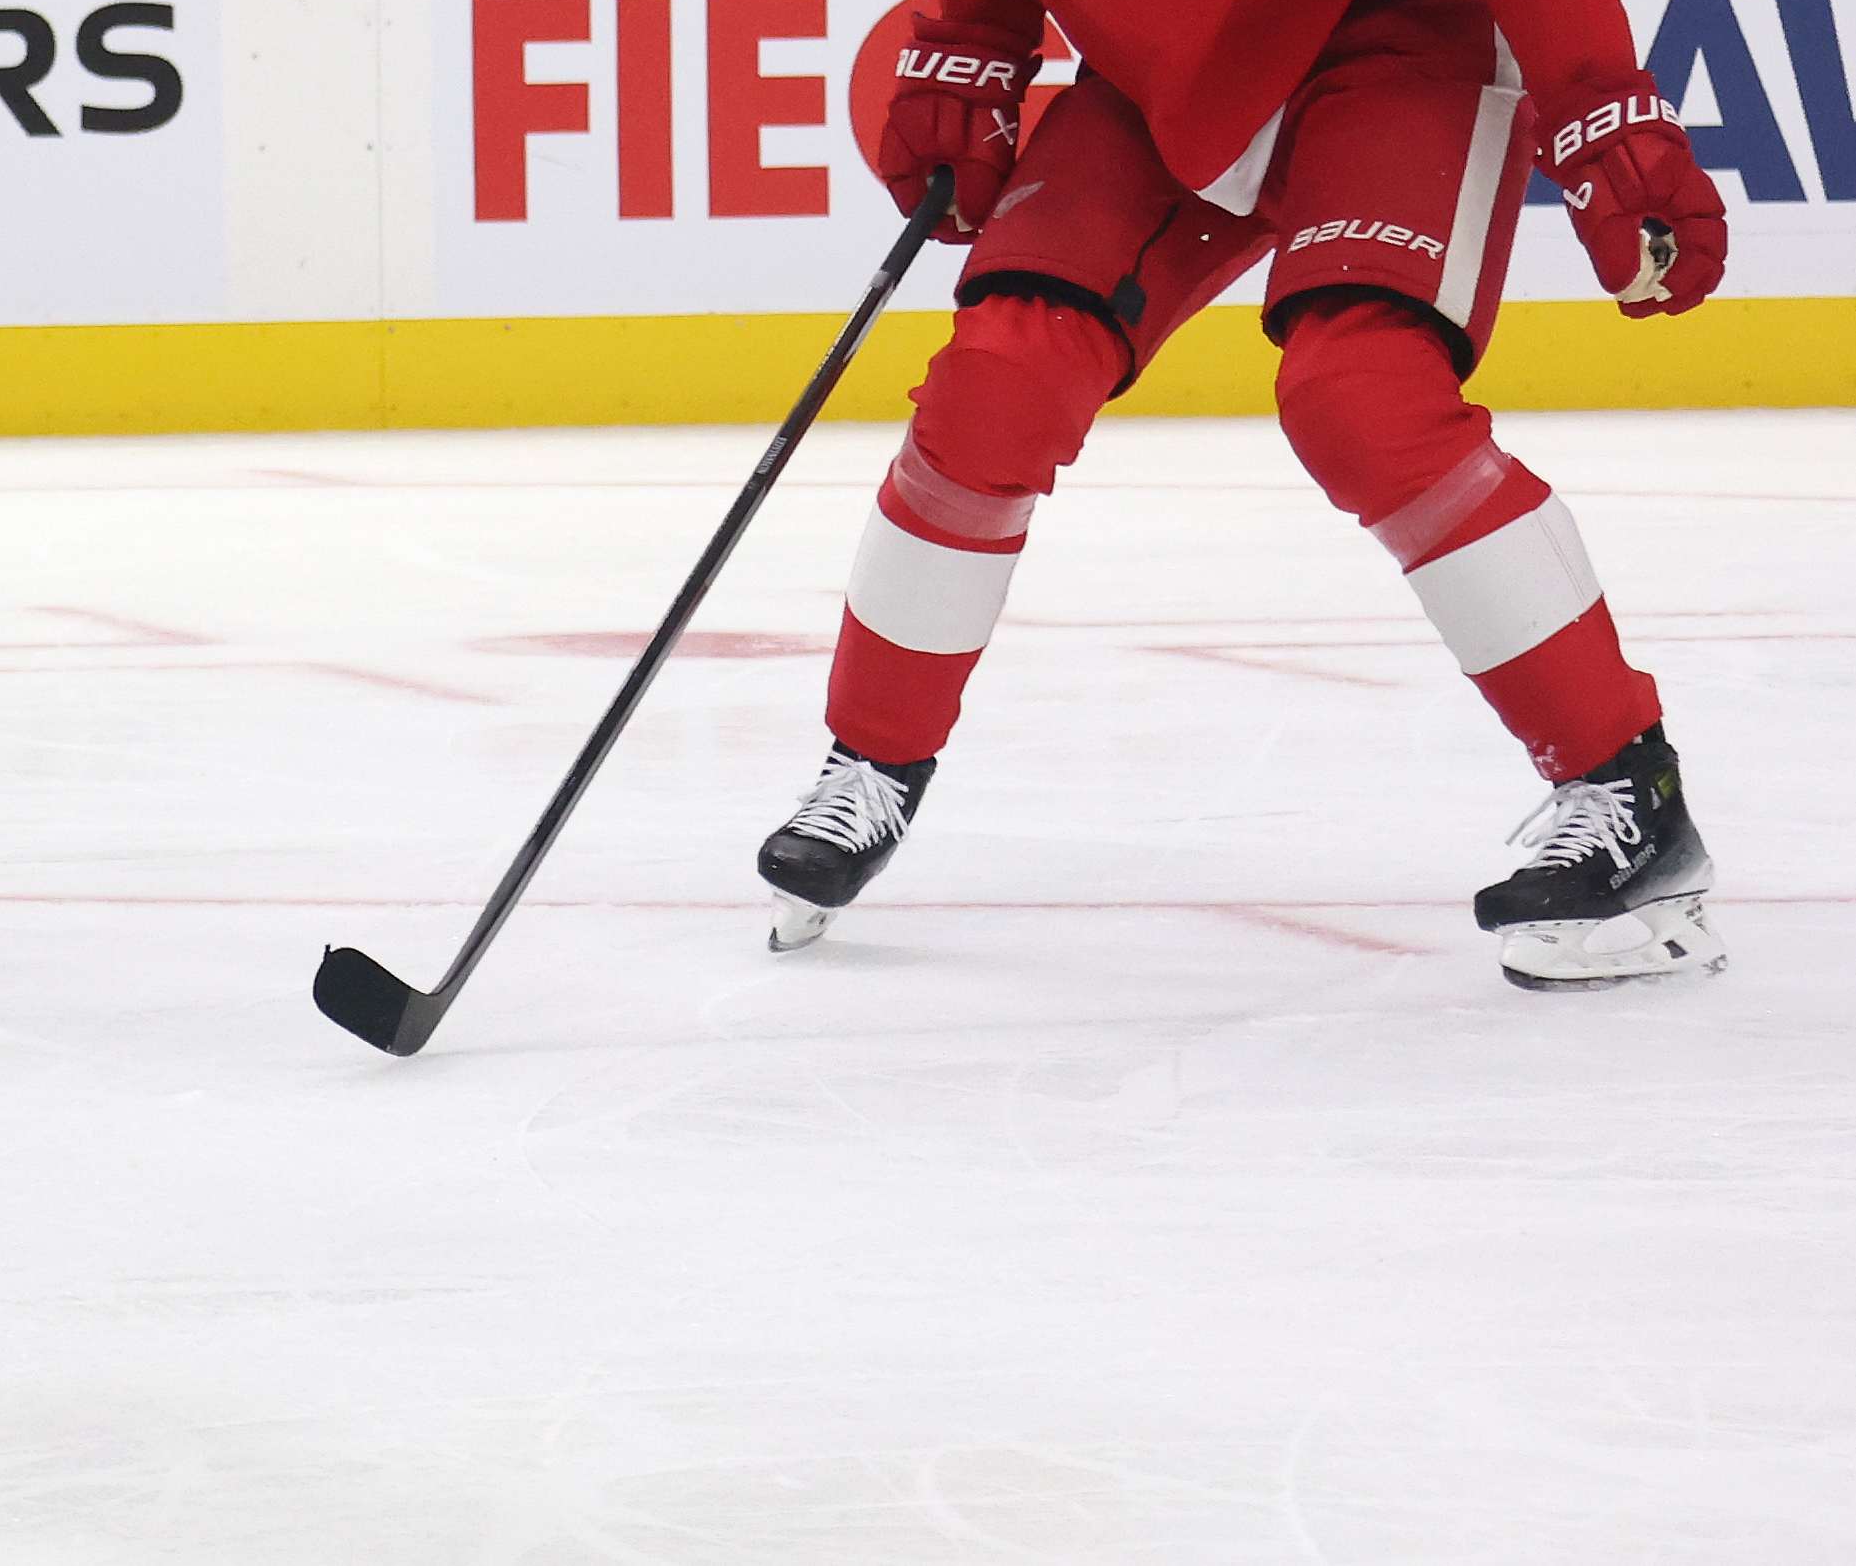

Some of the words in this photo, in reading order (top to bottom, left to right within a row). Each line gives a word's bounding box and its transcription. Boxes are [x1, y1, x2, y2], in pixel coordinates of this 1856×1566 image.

[896, 49, 1016, 91] UER
[1554, 95, 1687, 167] BAUE
[1287, 220, 1447, 262] BAUER
